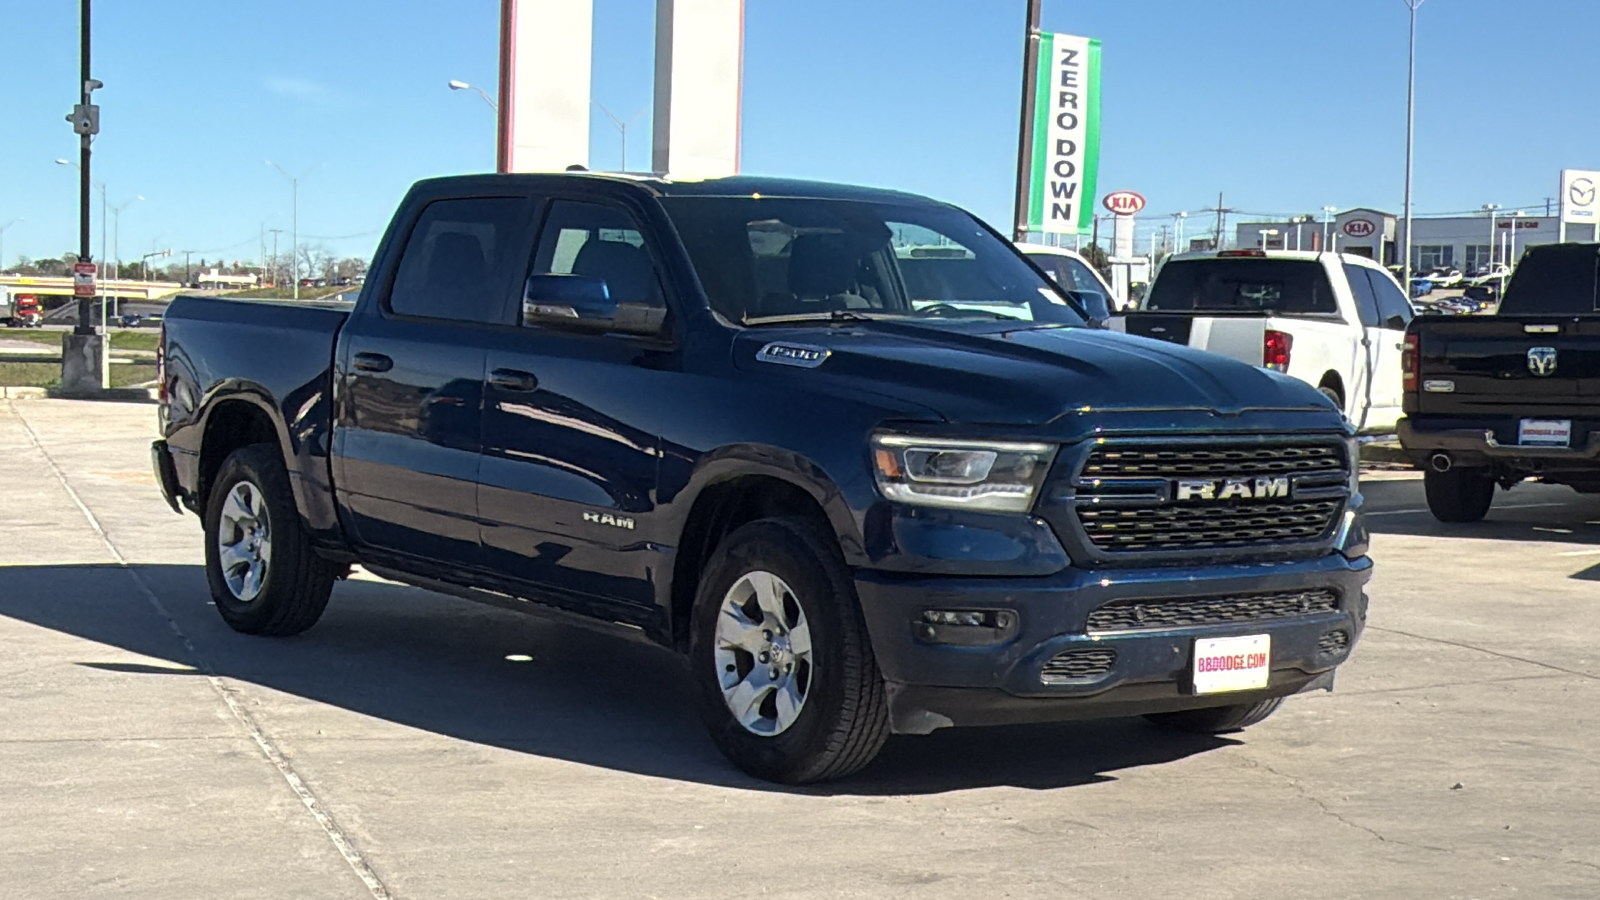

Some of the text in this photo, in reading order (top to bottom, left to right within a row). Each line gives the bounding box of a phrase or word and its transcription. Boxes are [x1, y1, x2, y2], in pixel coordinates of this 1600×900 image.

[1050, 48, 1079, 221] ZERO DOWN
[1112, 196, 1138, 209] KIA
[1348, 222, 1371, 233] KIA
[1177, 478, 1288, 500] RAM
[583, 510, 635, 530] RAM
